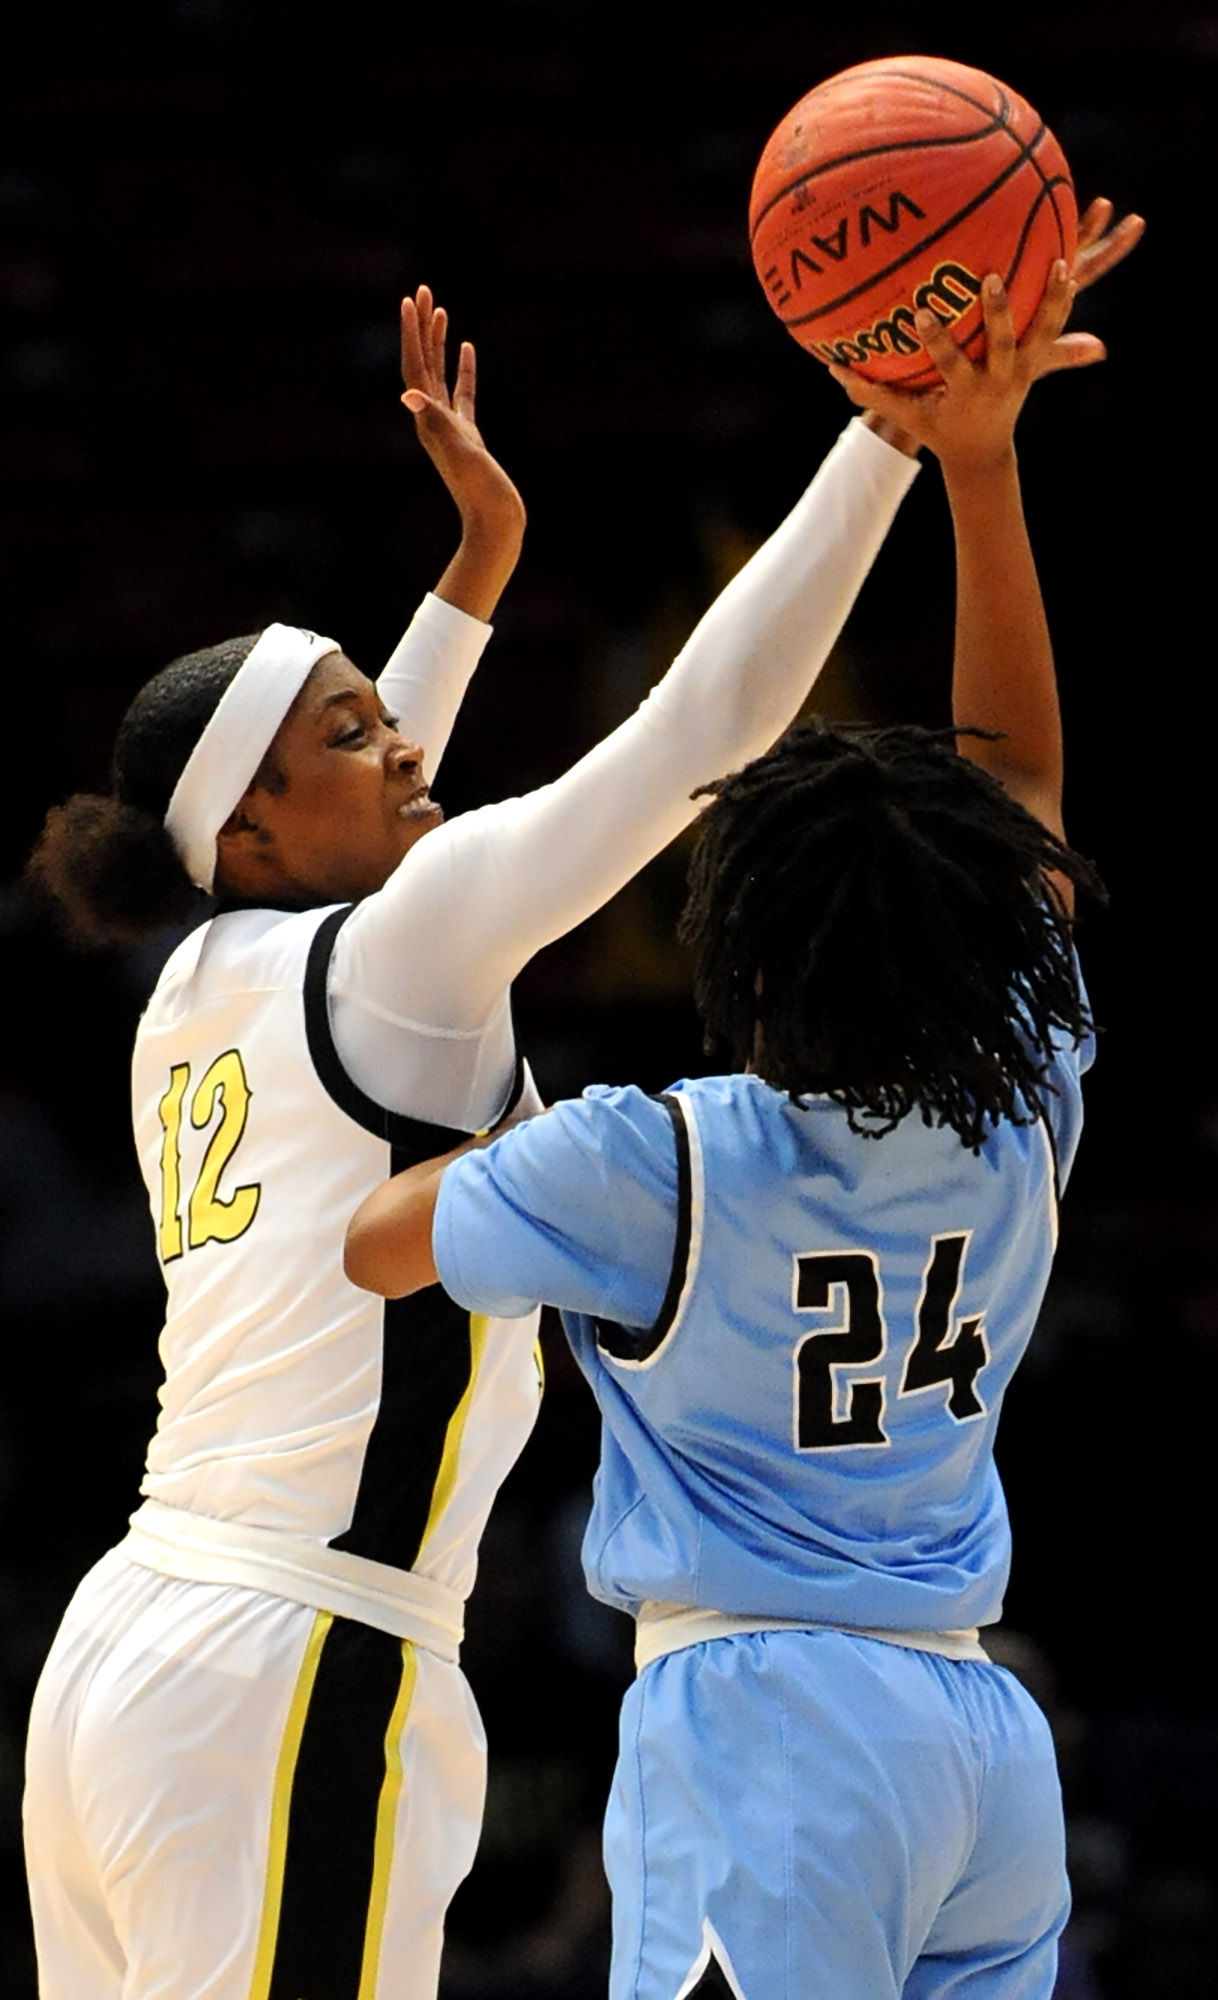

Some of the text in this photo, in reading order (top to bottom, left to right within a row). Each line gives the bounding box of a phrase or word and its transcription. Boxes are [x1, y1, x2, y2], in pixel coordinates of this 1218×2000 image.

[764, 191, 927, 308] WAVE
[158, 1048, 261, 1265] 12
[793, 1230, 990, 1453] 24
